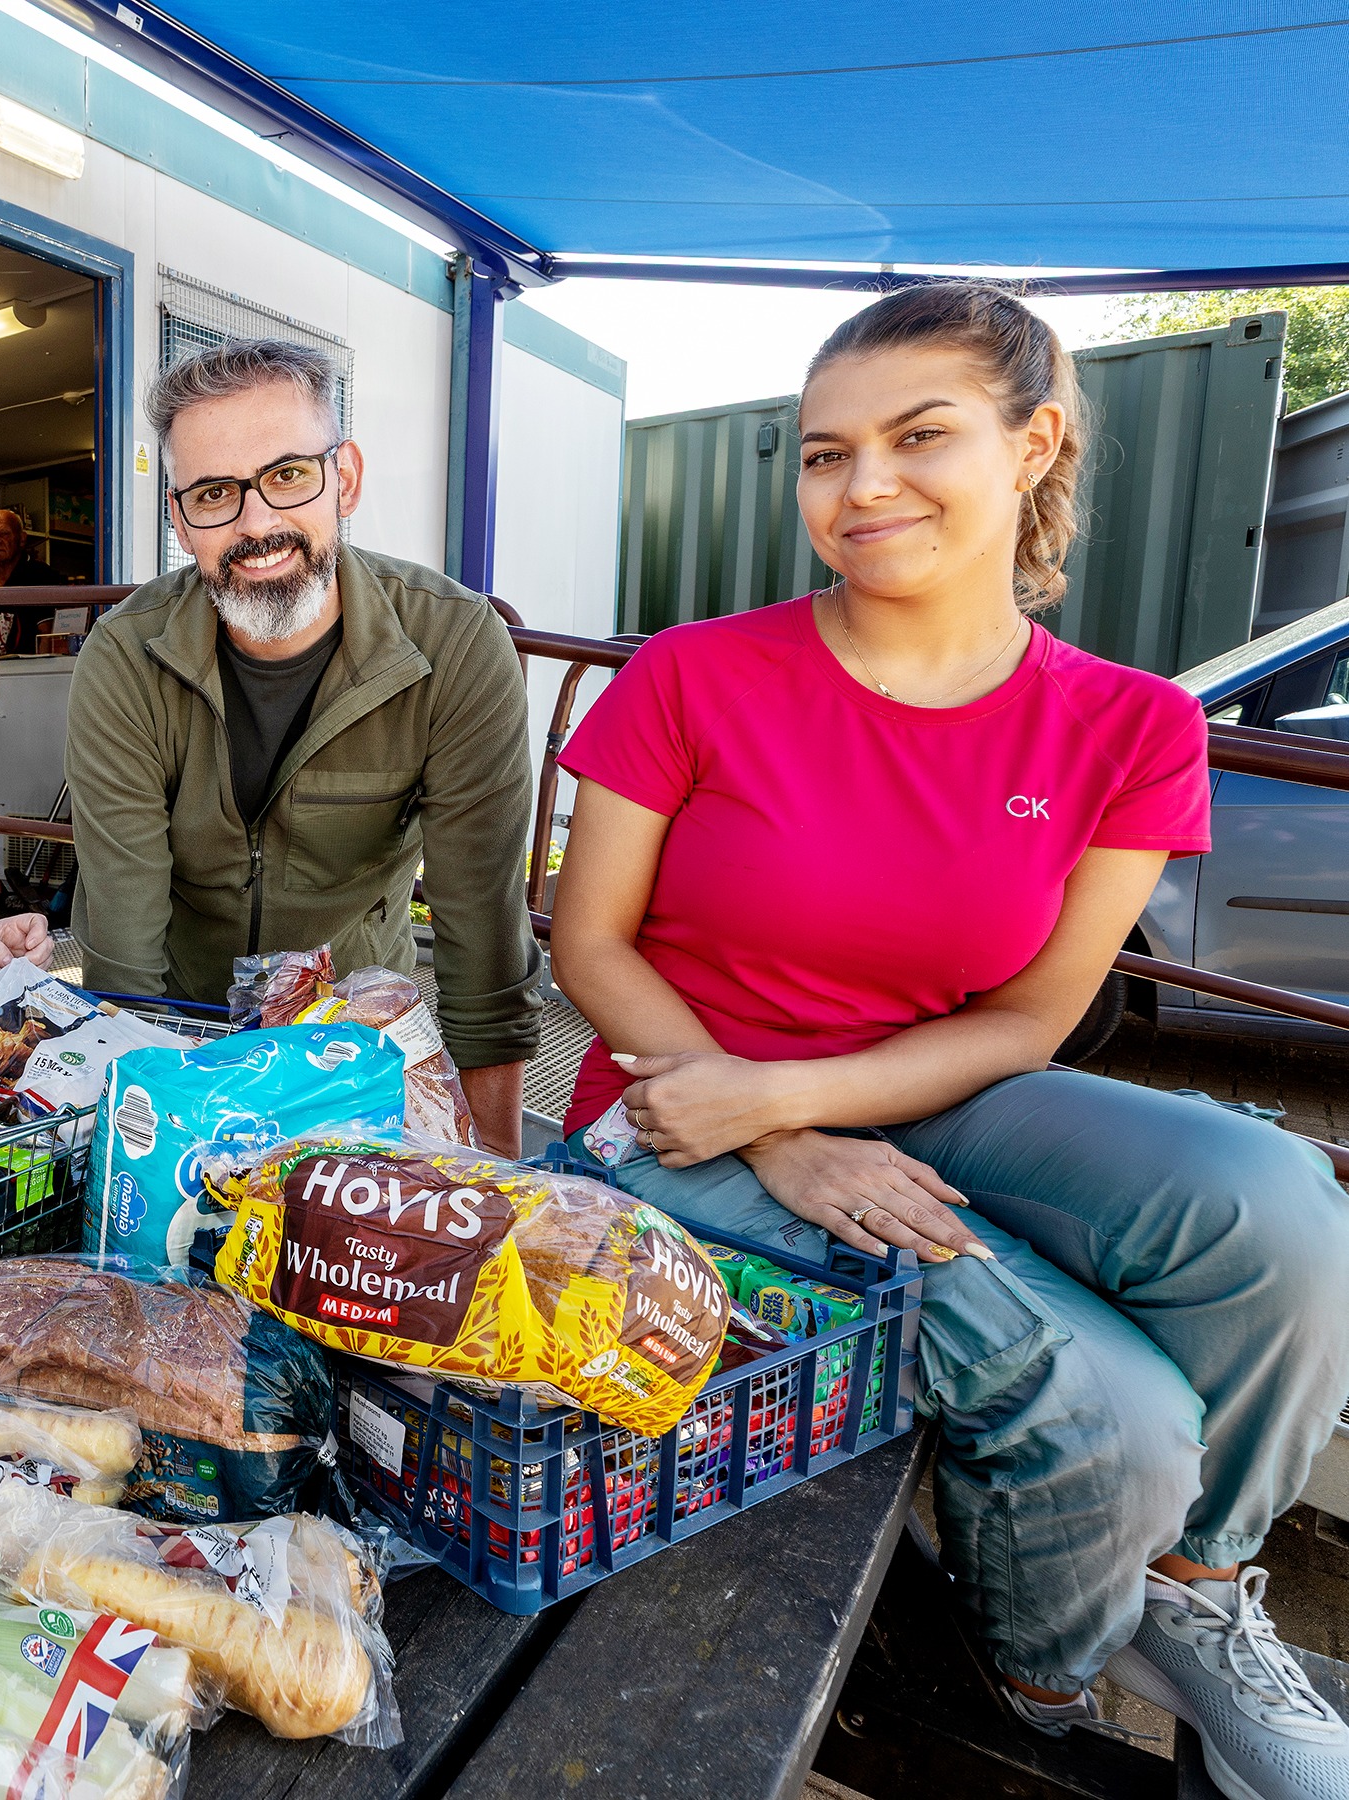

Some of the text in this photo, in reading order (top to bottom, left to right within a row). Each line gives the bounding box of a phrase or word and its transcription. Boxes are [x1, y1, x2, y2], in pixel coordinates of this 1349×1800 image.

[1005, 795, 1050, 820] CK
[34, 1057, 47, 1067] 15
[118, 1176, 133, 1232] mamia
[301, 1158, 485, 1239] HOVIS
[345, 1236, 398, 1272] Tasty
[651, 1239, 722, 1318] HOVIS
[673, 1299, 692, 1323] Tasty
[761, 1292, 774, 1322] SEAL
[771, 1292, 784, 1326] BARS
[644, 1338, 677, 1364] MDIUM
[371, 1423, 380, 1433] 2.27
[381, 1432, 387, 1440] kg
[47, 1648, 61, 1672] CERTIFIED
